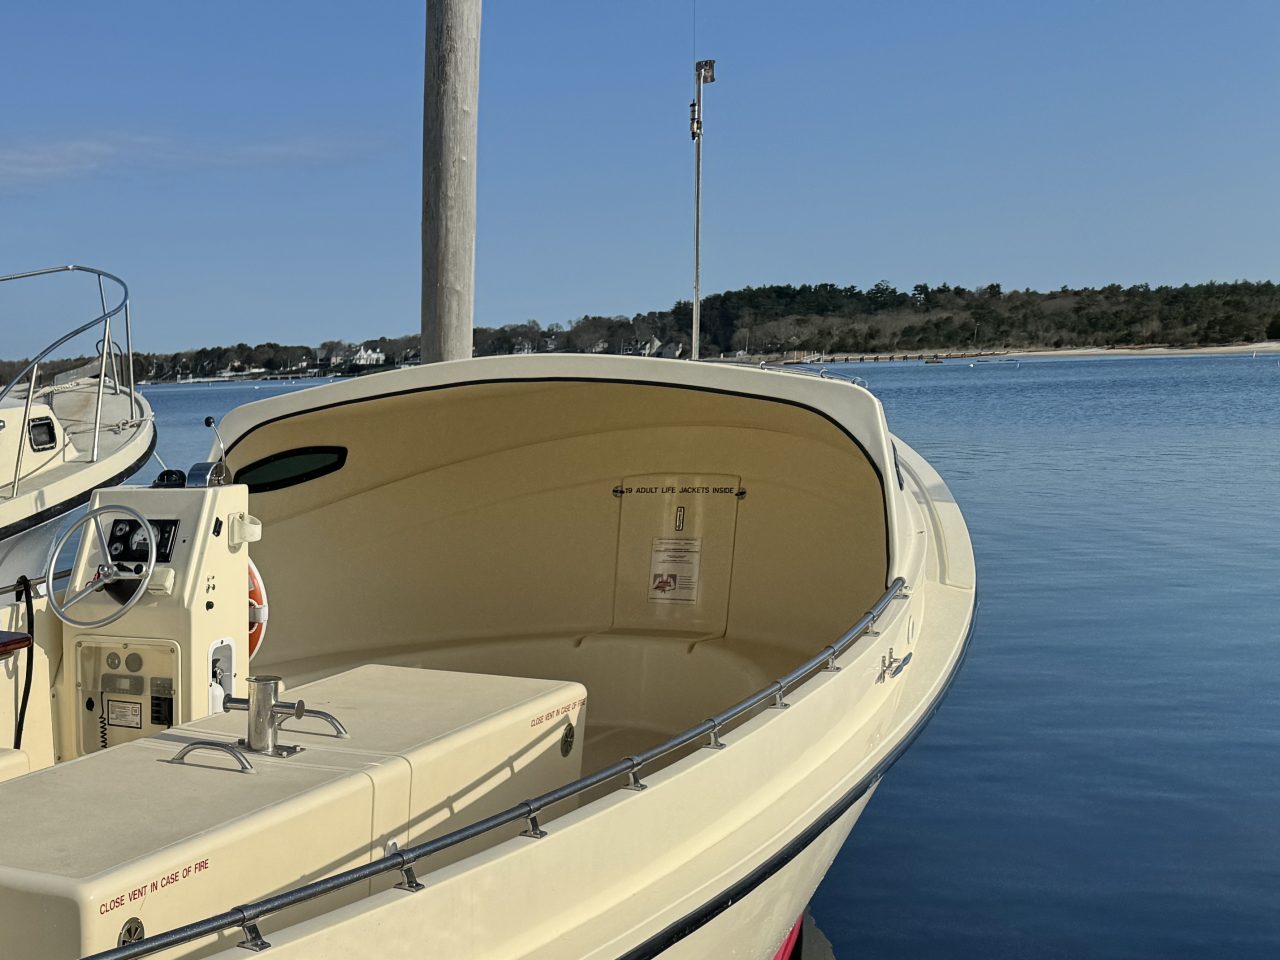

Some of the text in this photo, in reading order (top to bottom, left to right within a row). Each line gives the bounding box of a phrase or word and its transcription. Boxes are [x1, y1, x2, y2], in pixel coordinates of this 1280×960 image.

[635, 486, 659, 494] ADULT
[661, 486, 676, 494] LIFE
[678, 486, 710, 494] JACKETS
[99, 858, 209, 915] CLOSE VENT IN CASE OF FIRE
